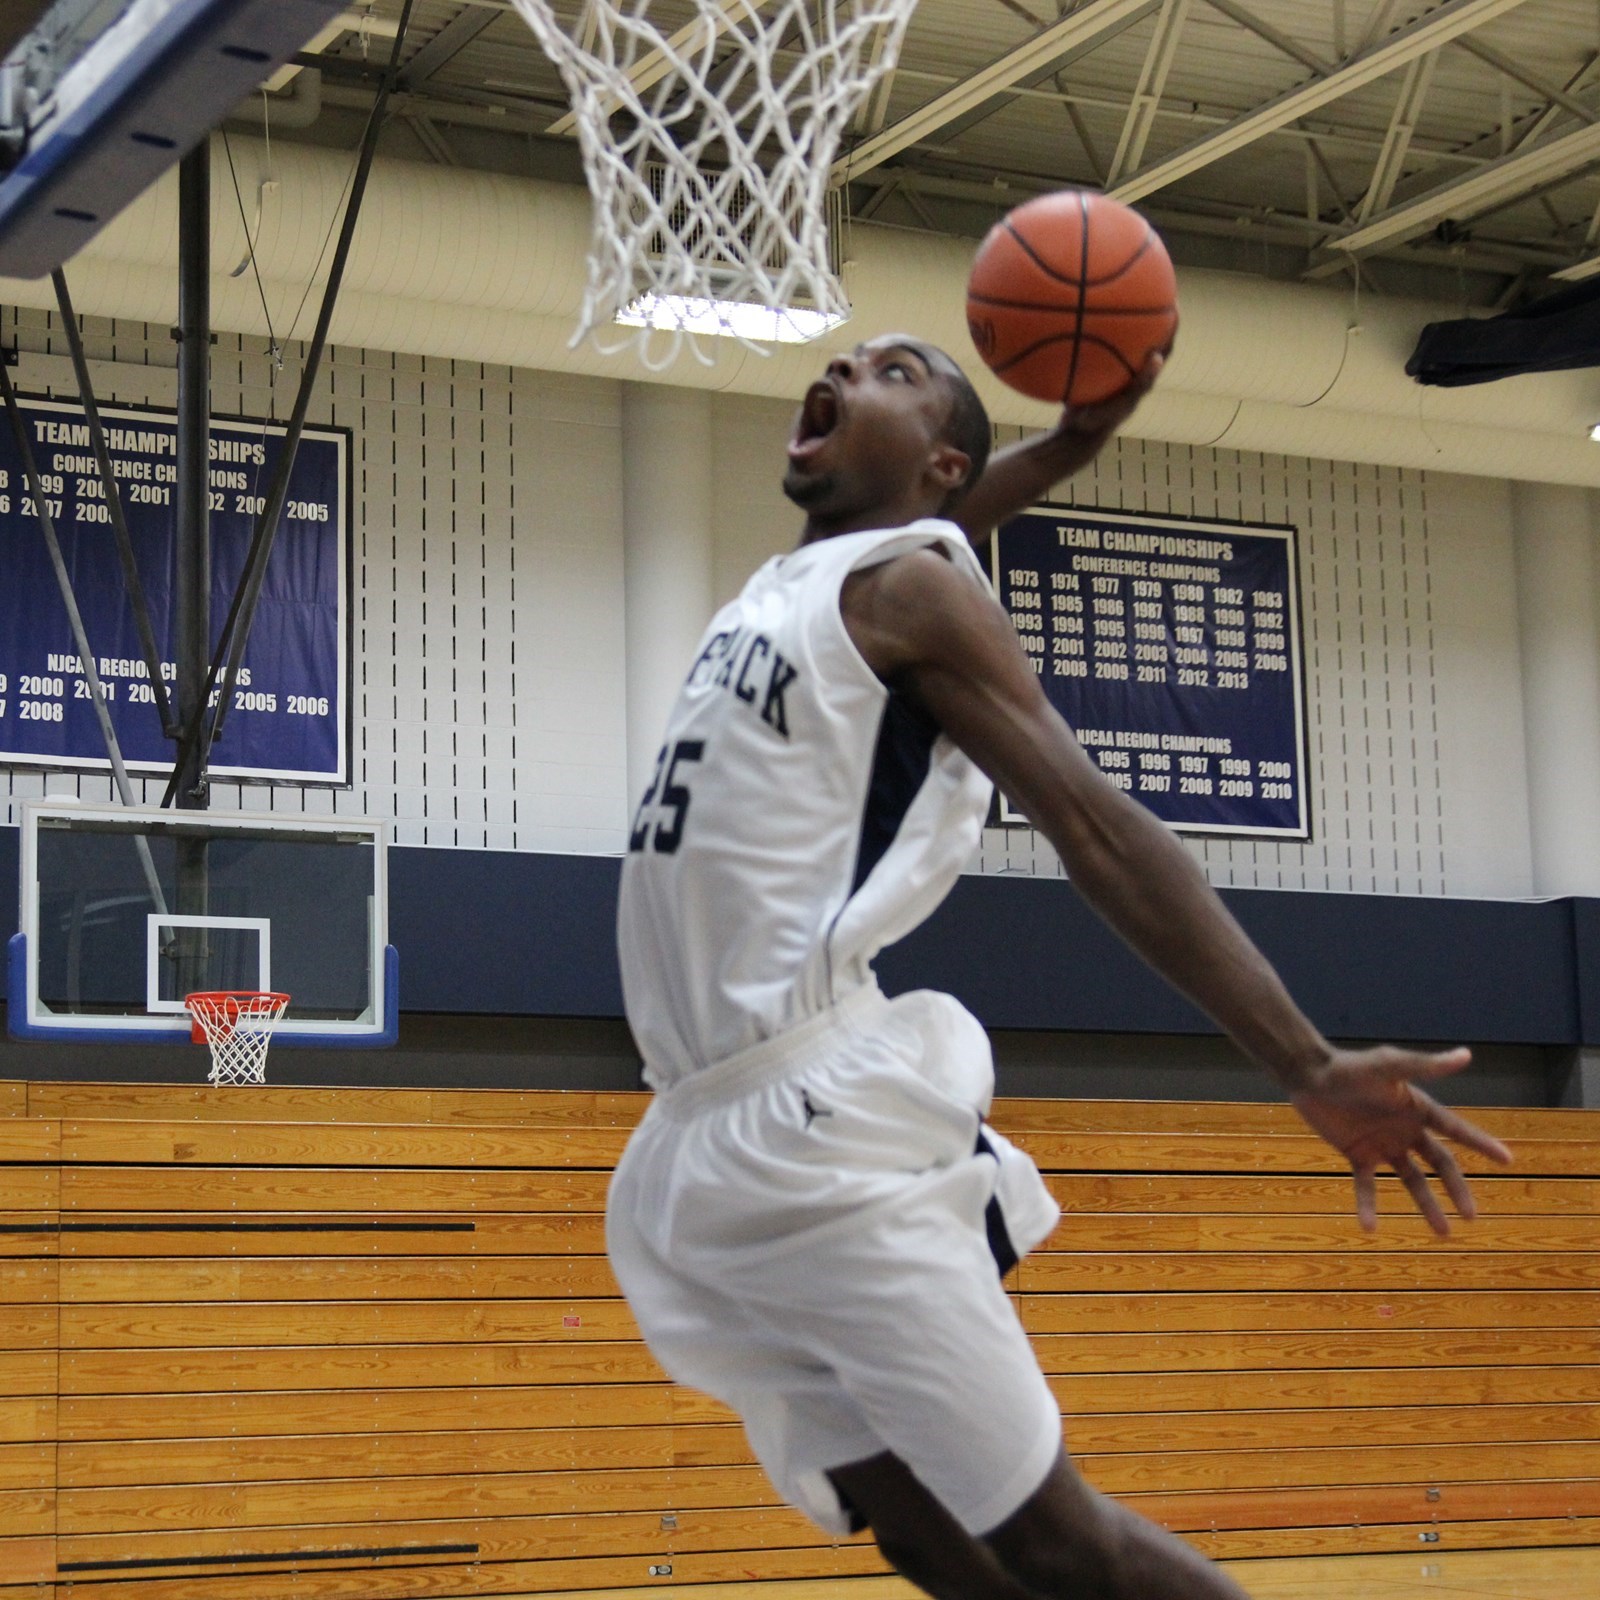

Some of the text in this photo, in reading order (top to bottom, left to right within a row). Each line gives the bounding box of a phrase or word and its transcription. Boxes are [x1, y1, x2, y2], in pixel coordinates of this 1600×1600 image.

[34, 420, 266, 466] TEAM CHAMPISHIPS
[53, 453, 248, 491] CONFENCE CHIONS
[21, 473, 64, 495] 199
[130, 484, 170, 506] 2001
[235, 495, 266, 516] 200
[287, 500, 329, 522] 2005
[75, 502, 113, 524] 200
[1056, 526, 1234, 562] TEAM CHAMPIONSHIPS
[1072, 554, 1221, 584] CONFERENCE CHAMPIONS
[1008, 569, 1284, 609] 1973 1974 1977 1979 1980 1982 1983
[1009, 590, 1284, 630] 1984 1985 1986 1987 1988 1990 1992
[1011, 612, 1285, 651] 1993 1994 1995 1996 1997 1998 1999
[47, 653, 97, 674] NJCA
[100, 657, 151, 680] REGIO
[1019, 634, 1287, 672] 000 2001 2002 2003 2004 2005 2006
[1053, 659, 1088, 678] 2008
[1095, 662, 1129, 681] 2009
[1137, 665, 1166, 684] 2011
[1177, 668, 1209, 687] 2012
[1217, 671, 1249, 690] 2013
[19, 675, 64, 698] 2000
[235, 691, 277, 713] 2005
[286, 695, 329, 717] 2006
[19, 700, 64, 723] 2008
[1076, 728, 1232, 754] NJCAA REGION CHAMPIONS
[1097, 750, 1292, 779] 1995 1996 1997 1999 2000
[629, 739, 707, 855] 25
[1139, 774, 1171, 792] 2007
[1179, 777, 1213, 795] 2008
[1219, 780, 1254, 798] 2009
[1260, 782, 1293, 800] 2010
